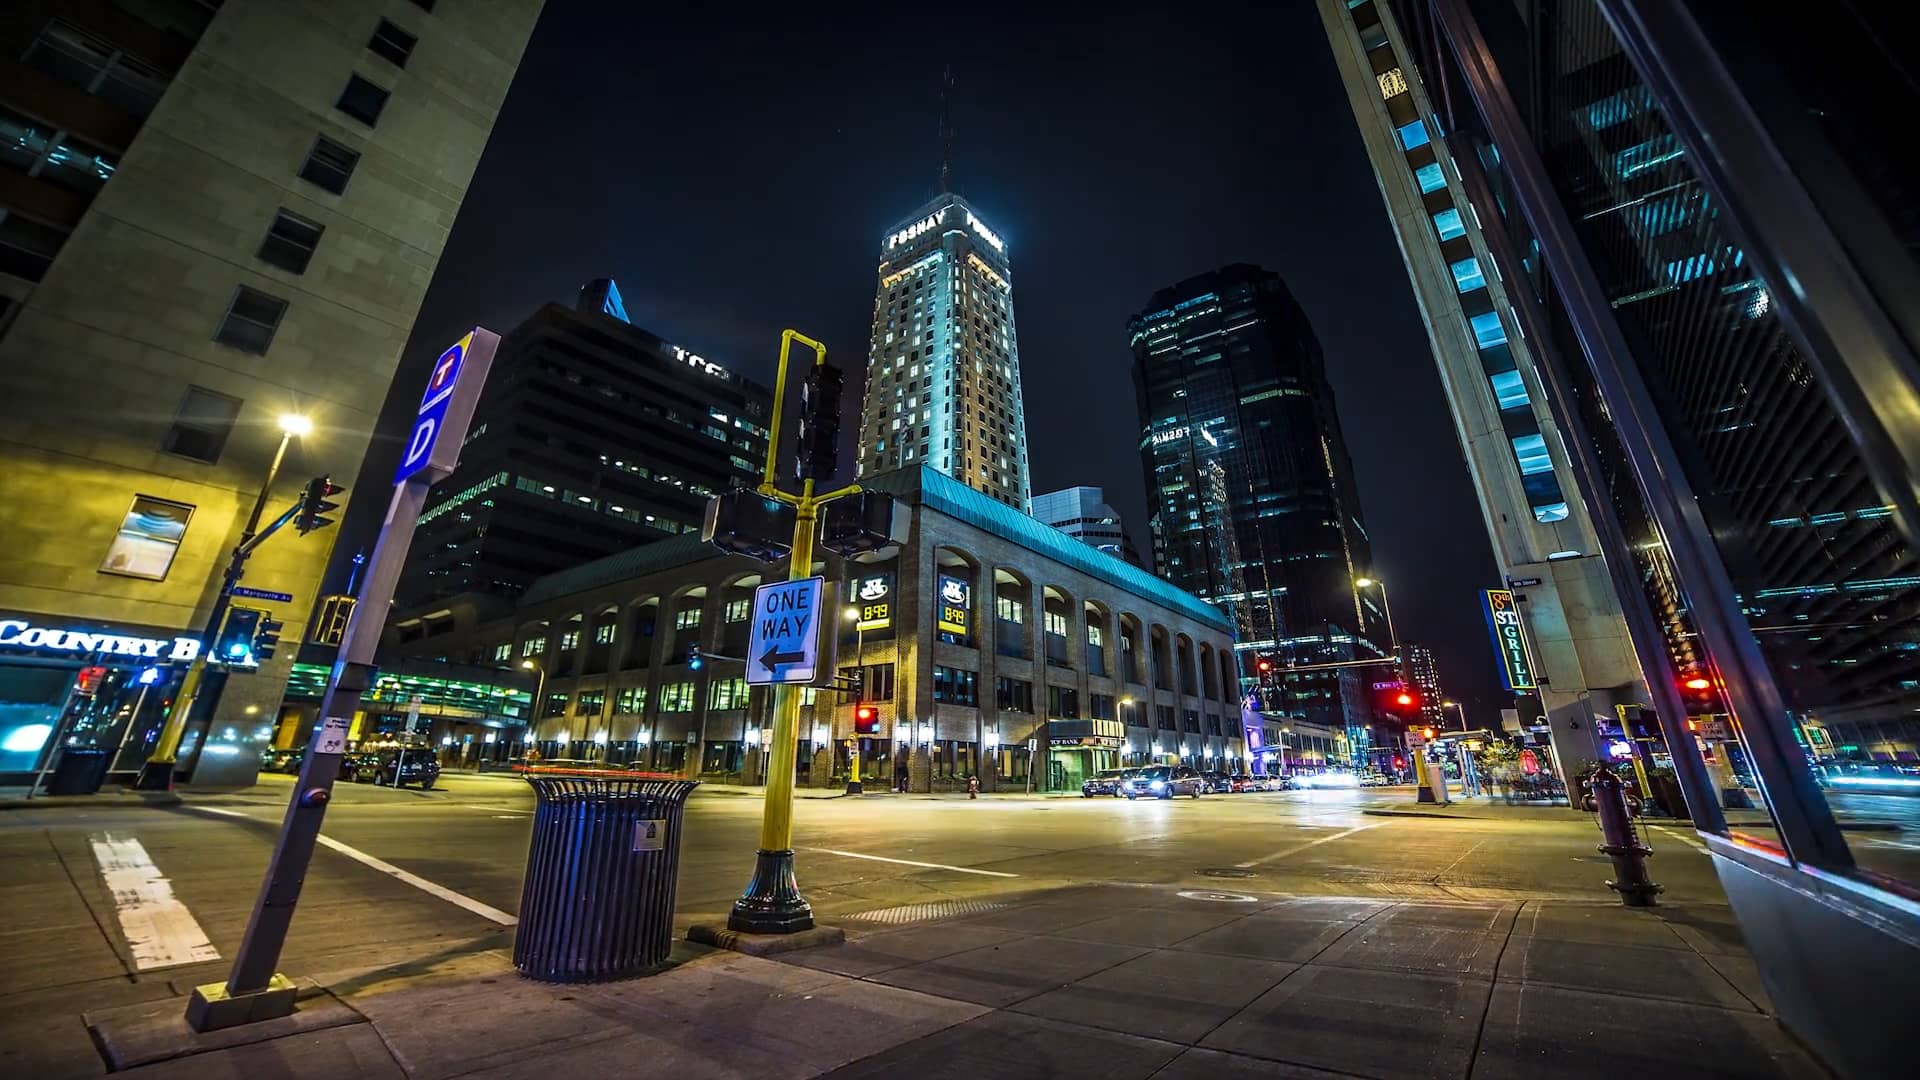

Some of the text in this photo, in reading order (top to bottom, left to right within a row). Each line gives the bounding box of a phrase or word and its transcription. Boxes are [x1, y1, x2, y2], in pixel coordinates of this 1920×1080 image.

[889, 210, 945, 249] FOSHAY
[405, 419, 435, 467] D
[767, 588, 809, 613] ONE
[1492, 593, 1510, 609] 8th
[762, 615, 808, 640] WAY
[1496, 611, 1517, 624] ST.
[1504, 627, 1529, 686] GRILL
